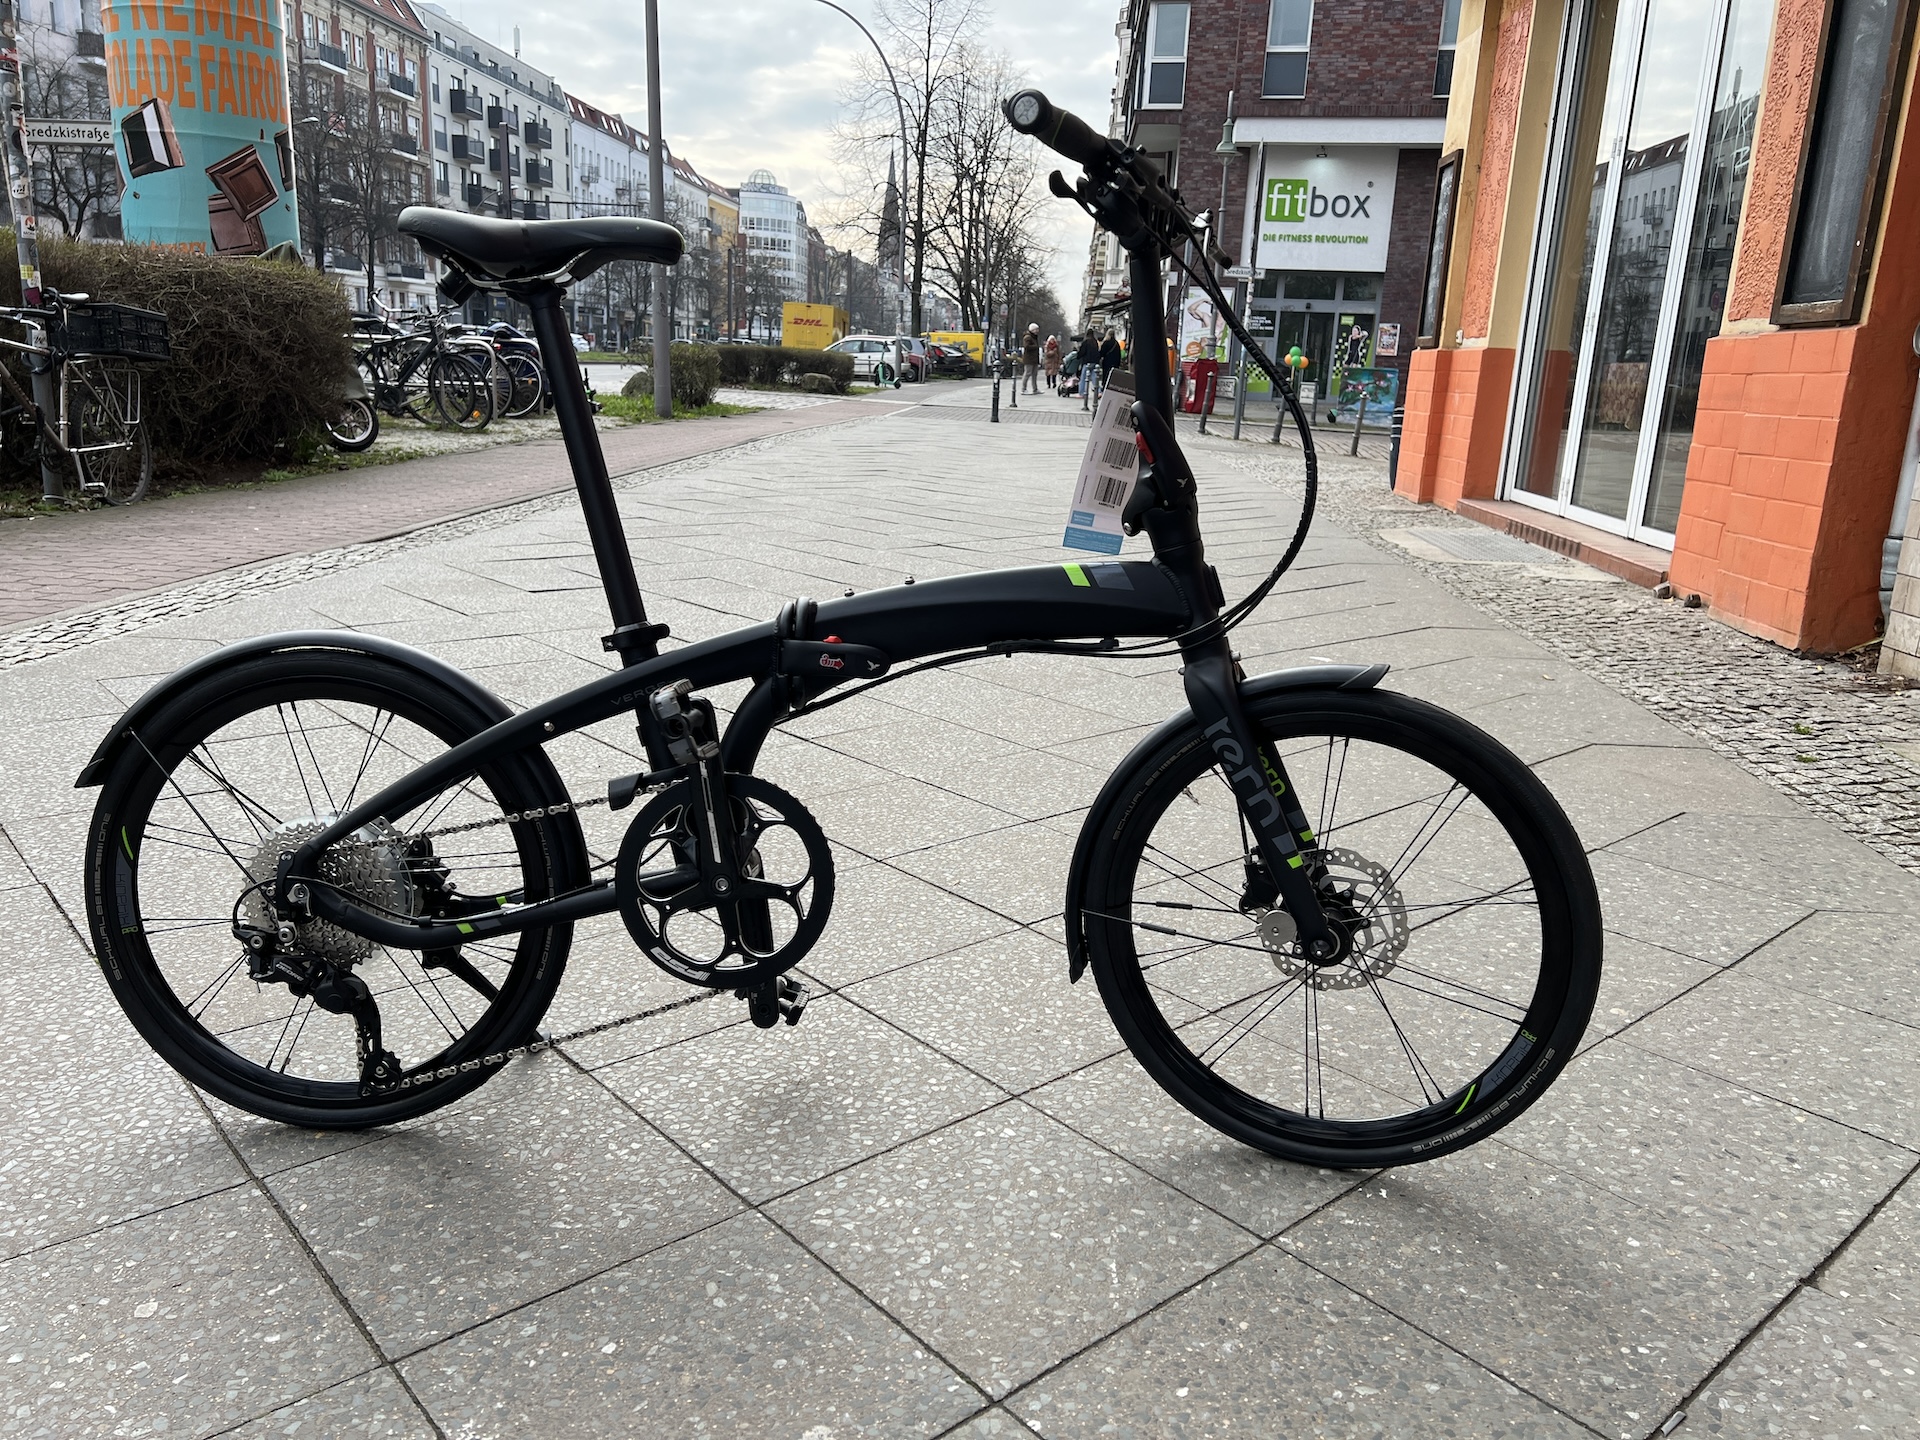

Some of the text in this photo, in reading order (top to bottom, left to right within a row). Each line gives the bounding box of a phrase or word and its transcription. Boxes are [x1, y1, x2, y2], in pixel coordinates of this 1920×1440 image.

[1268, 182, 1371, 218] fitbox
[1262, 233, 1369, 245] DIE FITNESS REVOLUTION
[793, 317, 822, 327] DHL
[1112, 769, 1162, 842] SCHWALBE
[94, 895, 123, 982] SCHWALBE
[1490, 1047, 1556, 1119] SCHWALBE
[1411, 1138, 1443, 1153] ONE
